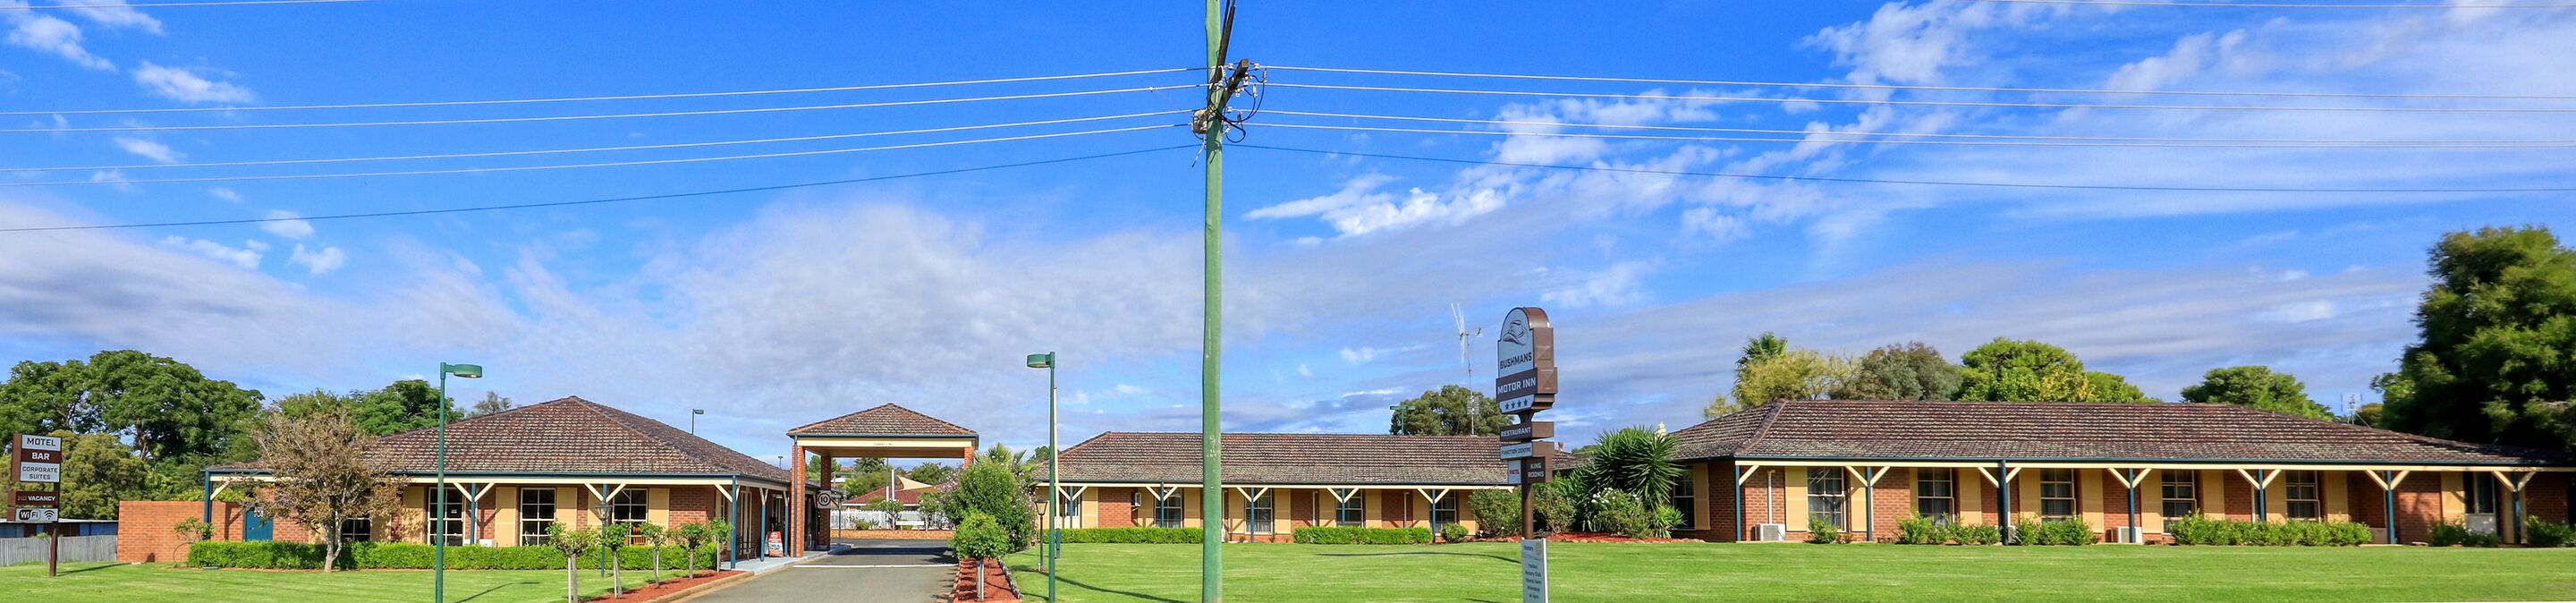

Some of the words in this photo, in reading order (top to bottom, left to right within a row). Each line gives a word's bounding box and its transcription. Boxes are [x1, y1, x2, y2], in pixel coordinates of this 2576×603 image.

[1500, 352, 1532, 369] BUSHMANS
[1497, 381, 1521, 395] MOTOR
[1522, 377, 1536, 388] INN
[1500, 427, 1531, 437] RESTAURANT
[27, 437, 55, 446] MOTEL
[31, 452, 50, 460] BAR
